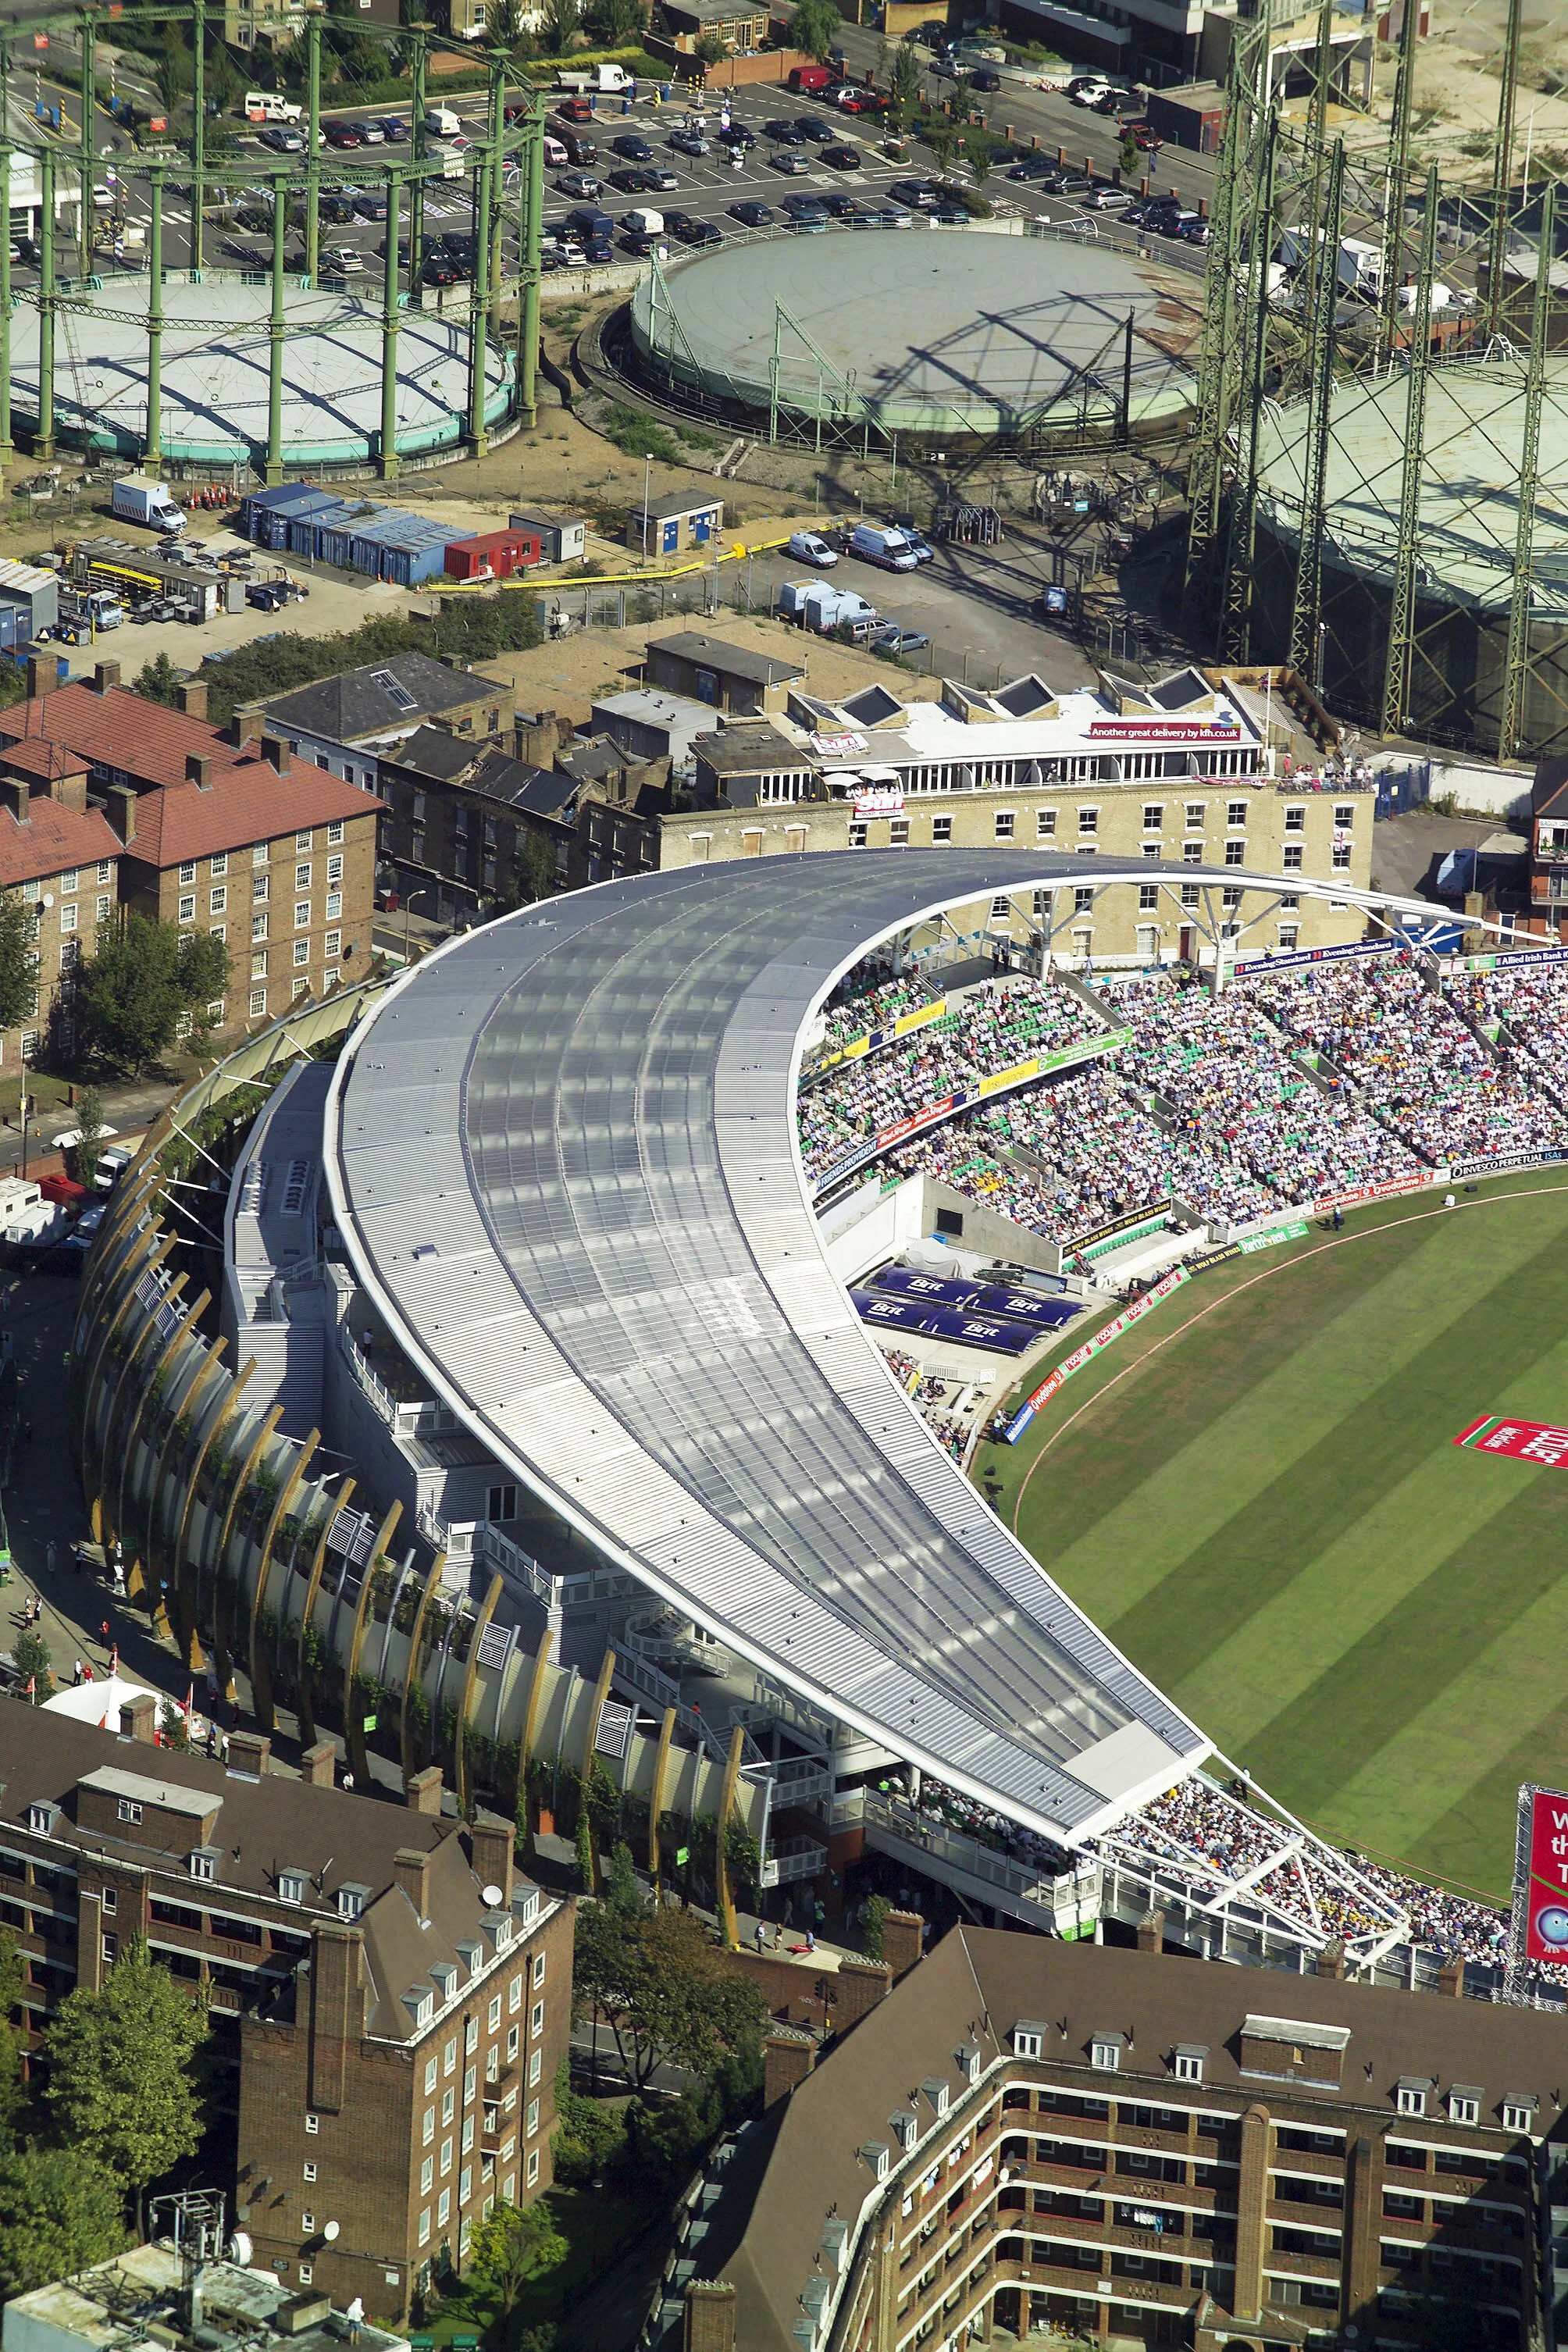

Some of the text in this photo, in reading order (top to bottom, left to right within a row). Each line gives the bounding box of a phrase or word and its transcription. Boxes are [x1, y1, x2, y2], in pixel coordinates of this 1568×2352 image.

[1092, 728, 1238, 739] Another great delivery by kfh.co.uk
[820, 737, 858, 750] Sun
[1322, 942, 1392, 959] Evening Standard
[1502, 956, 1523, 965] Allied
[1525, 953, 1541, 962] Irish
[1543, 952, 1562, 960] Bank
[1245, 954, 1311, 971] Evening Standard
[821, 1139, 878, 1188] FRIENDS PROVIDENT
[1463, 1151, 1563, 1174] INVESCO PERPETUAL ISAs
[1380, 1178, 1420, 1193] vodafone
[1321, 1192, 1359, 1210] vodafone
[1210, 1252, 1226, 1266] BLASS
[1224, 1246, 1242, 1260] WINES
[911, 1278, 945, 1292] Brit
[1157, 1273, 1180, 1295] npower
[871, 1303, 906, 1316] Brit
[1007, 1299, 1043, 1312] Brit
[1127, 1297, 1150, 1320] npower
[964, 1323, 1000, 1337] Brit
[1096, 1320, 1121, 1345] npower
[1065, 1345, 1089, 1370] npower
[1035, 1379, 1059, 1406] vodafone
